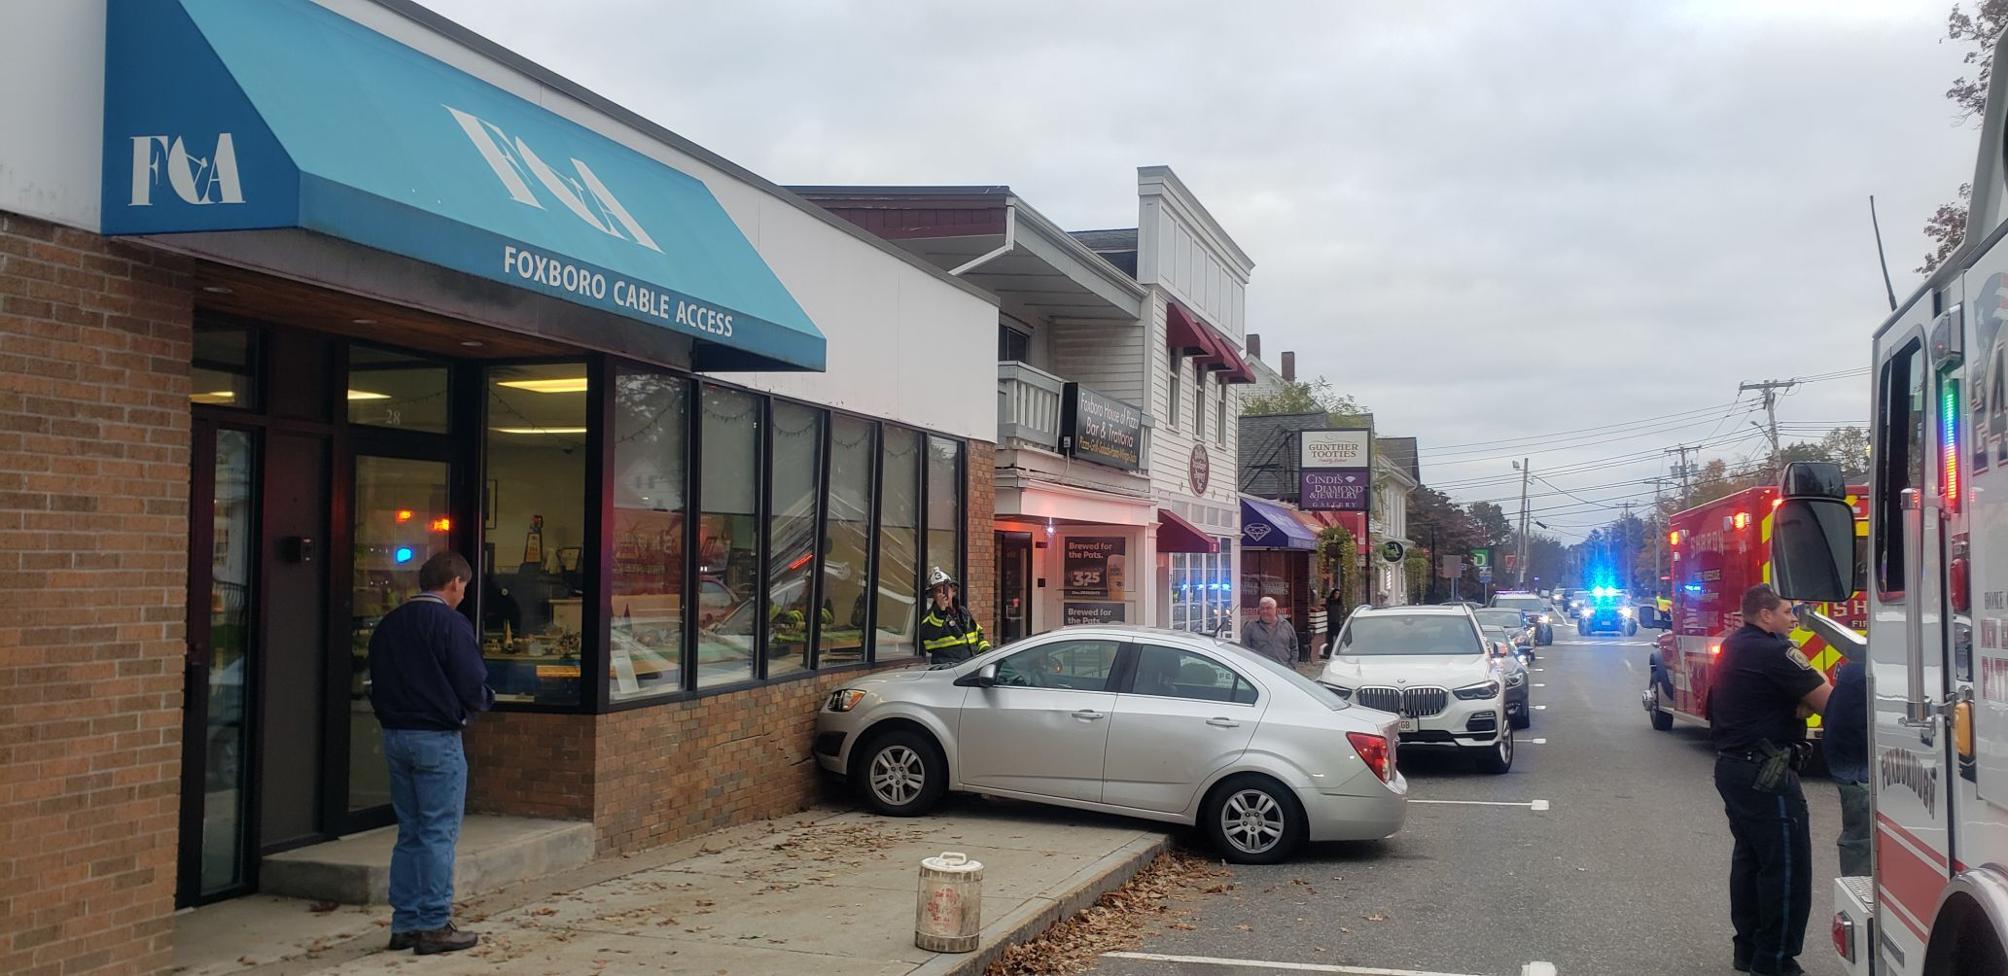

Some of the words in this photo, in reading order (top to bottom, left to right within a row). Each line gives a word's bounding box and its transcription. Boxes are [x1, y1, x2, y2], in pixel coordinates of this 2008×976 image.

[504, 246, 606, 299] FOXBORO
[613, 281, 670, 320] CABLE
[675, 300, 733, 337] ACCESS
[1081, 392, 1103, 416] Foxboro
[1104, 402, 1119, 423] House
[1120, 407, 1127, 424] of
[1126, 410, 1139, 430] Pizza
[385, 409, 400, 425] 28
[1086, 416, 1099, 436] Bar
[1100, 421, 1106, 439] &
[1108, 423, 1134, 447] Trattoria
[1309, 443, 1359, 451] GUNTHER
[1312, 450, 1357, 458] TOOTIES
[1315, 485, 1363, 493] DIAMOND
[1069, 542, 1099, 550] Brewed
[1100, 542, 1112, 550] for
[1690, 529, 1724, 559] SHARON
[1069, 551, 1082, 559] the
[1083, 551, 1103, 559] Pats.
[1068, 608, 1098, 616] Brewed
[1100, 608, 1112, 616] for
[1068, 617, 1081, 625] the
